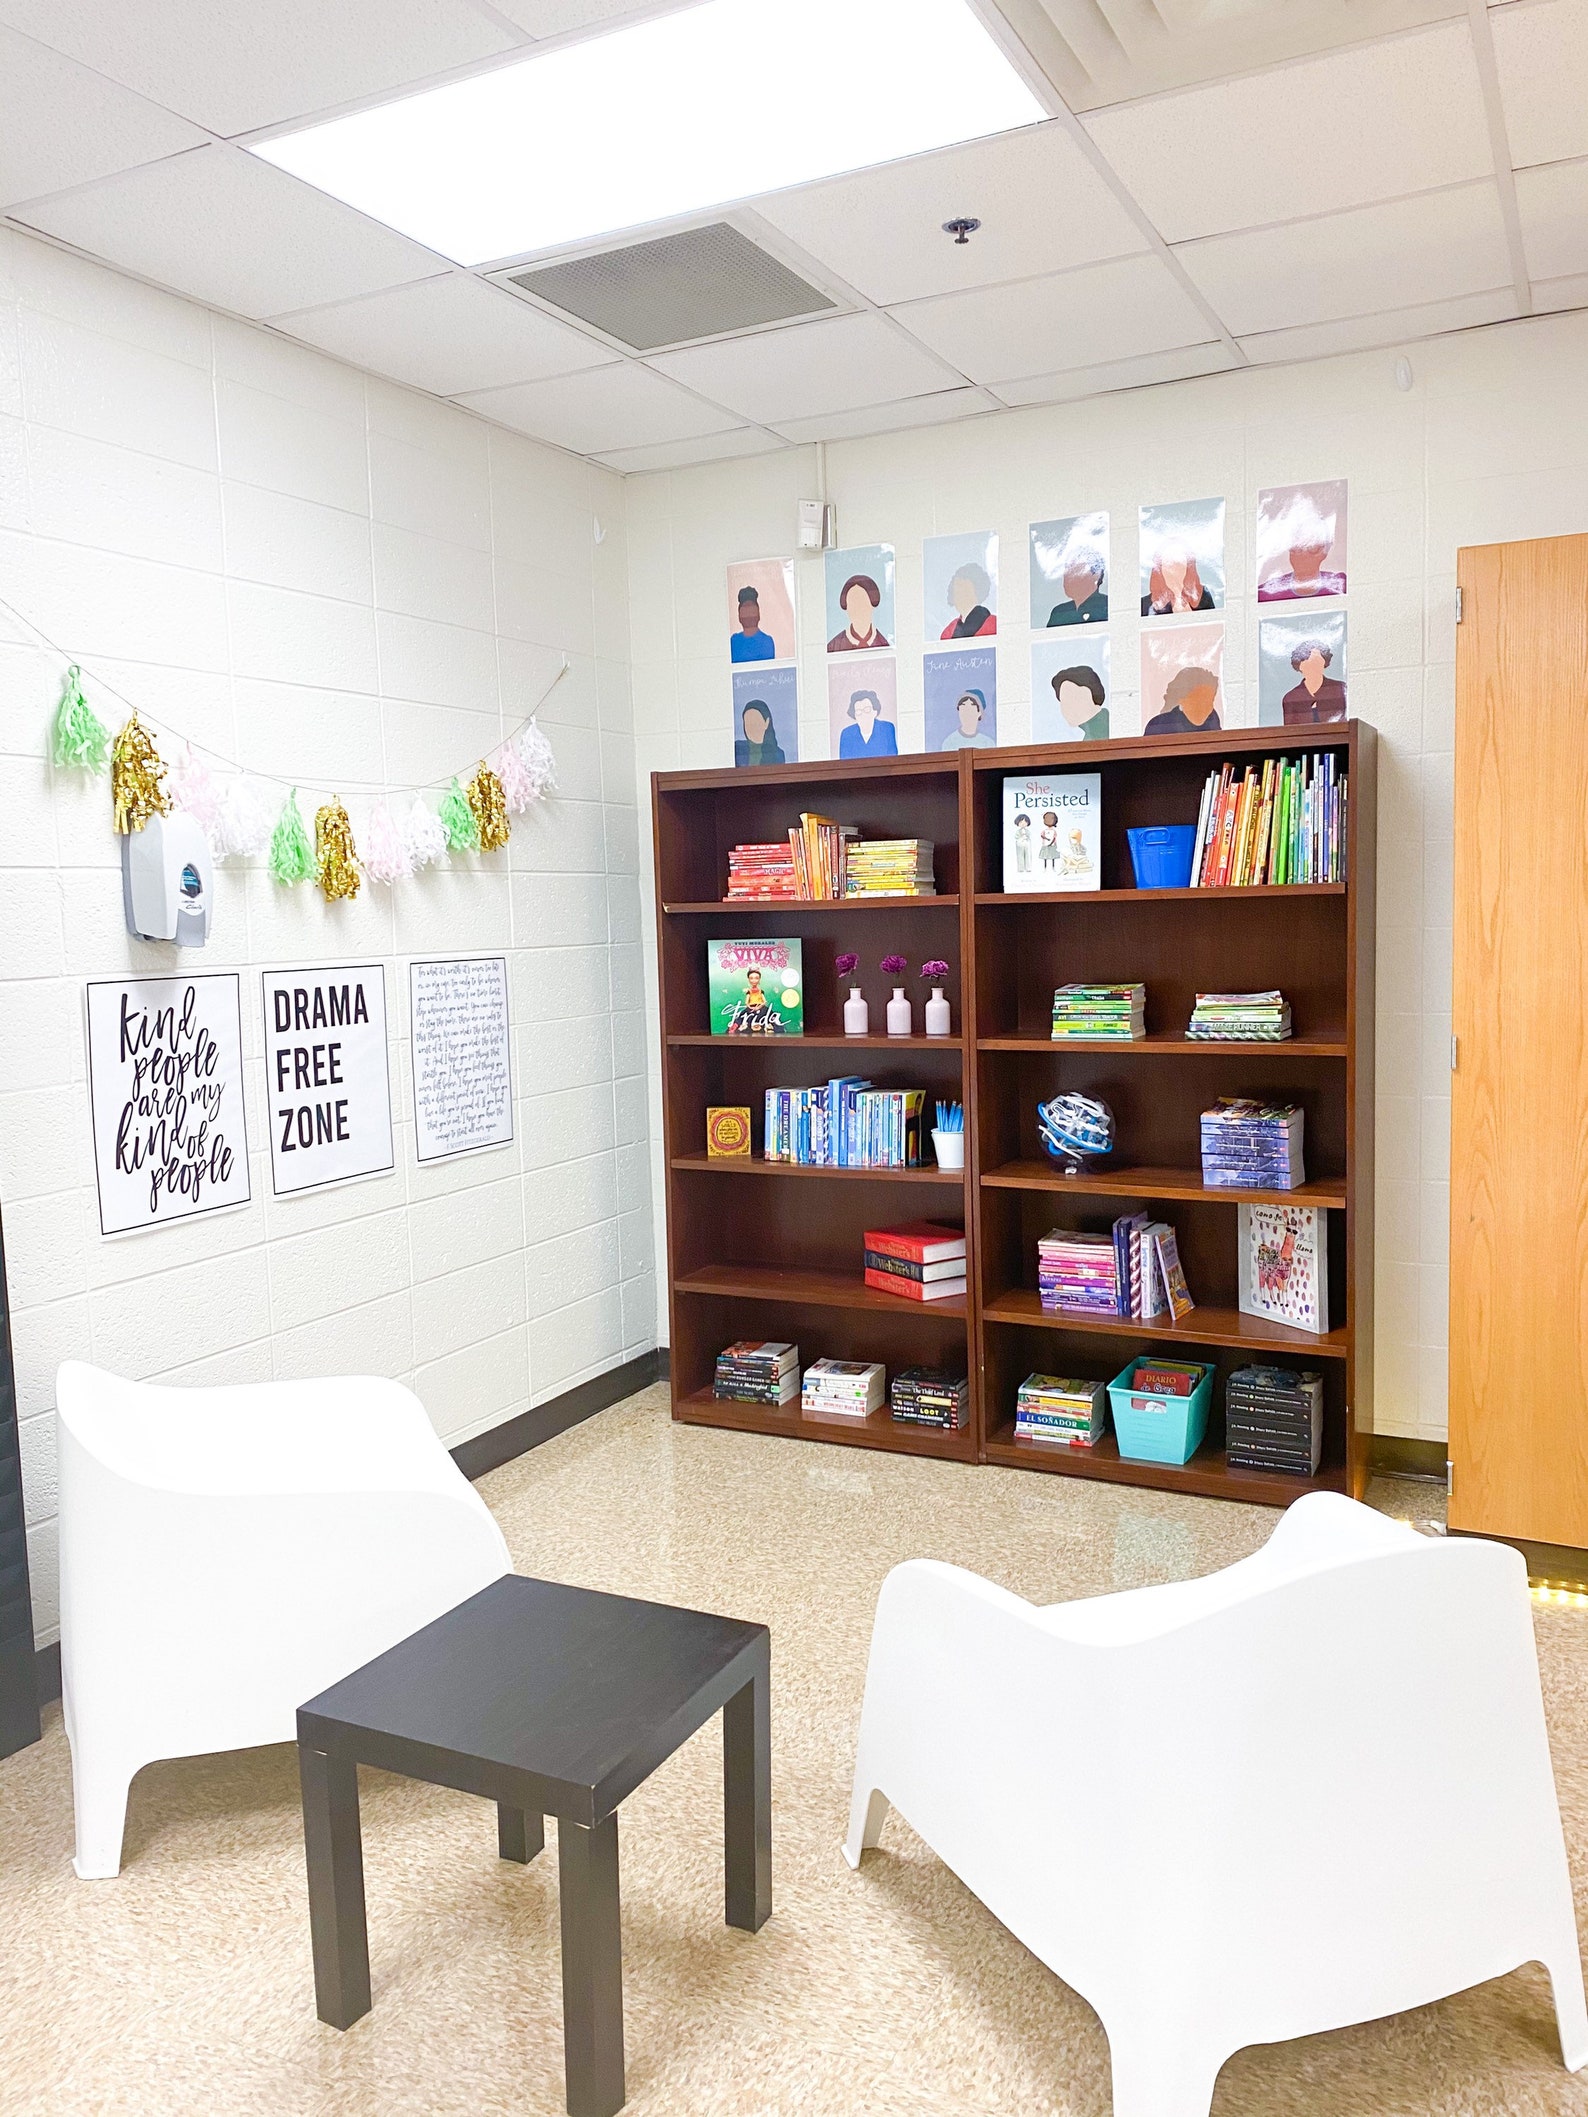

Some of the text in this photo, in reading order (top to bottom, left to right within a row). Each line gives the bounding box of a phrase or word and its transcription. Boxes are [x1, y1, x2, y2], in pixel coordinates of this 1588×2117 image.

[1014, 789, 1090, 808] Persisted
[1026, 782, 1050, 795] She
[733, 947, 775, 961] VIVA
[120, 986, 196, 1062] kind
[274, 984, 369, 1032] DRAMA
[721, 1001, 791, 1026] Frida
[132, 1028, 219, 1102] people
[277, 1043, 343, 1092] FREE
[139, 1082, 226, 1121] are my
[116, 1096, 209, 1174] kind of
[279, 1100, 350, 1152] ZONE
[150, 1134, 234, 1213] people
[879, 1258, 910, 1275] Webster's
[1146, 1375, 1176, 1384] DIARIO
[1038, 1415, 1077, 1427] SOÑADOR
